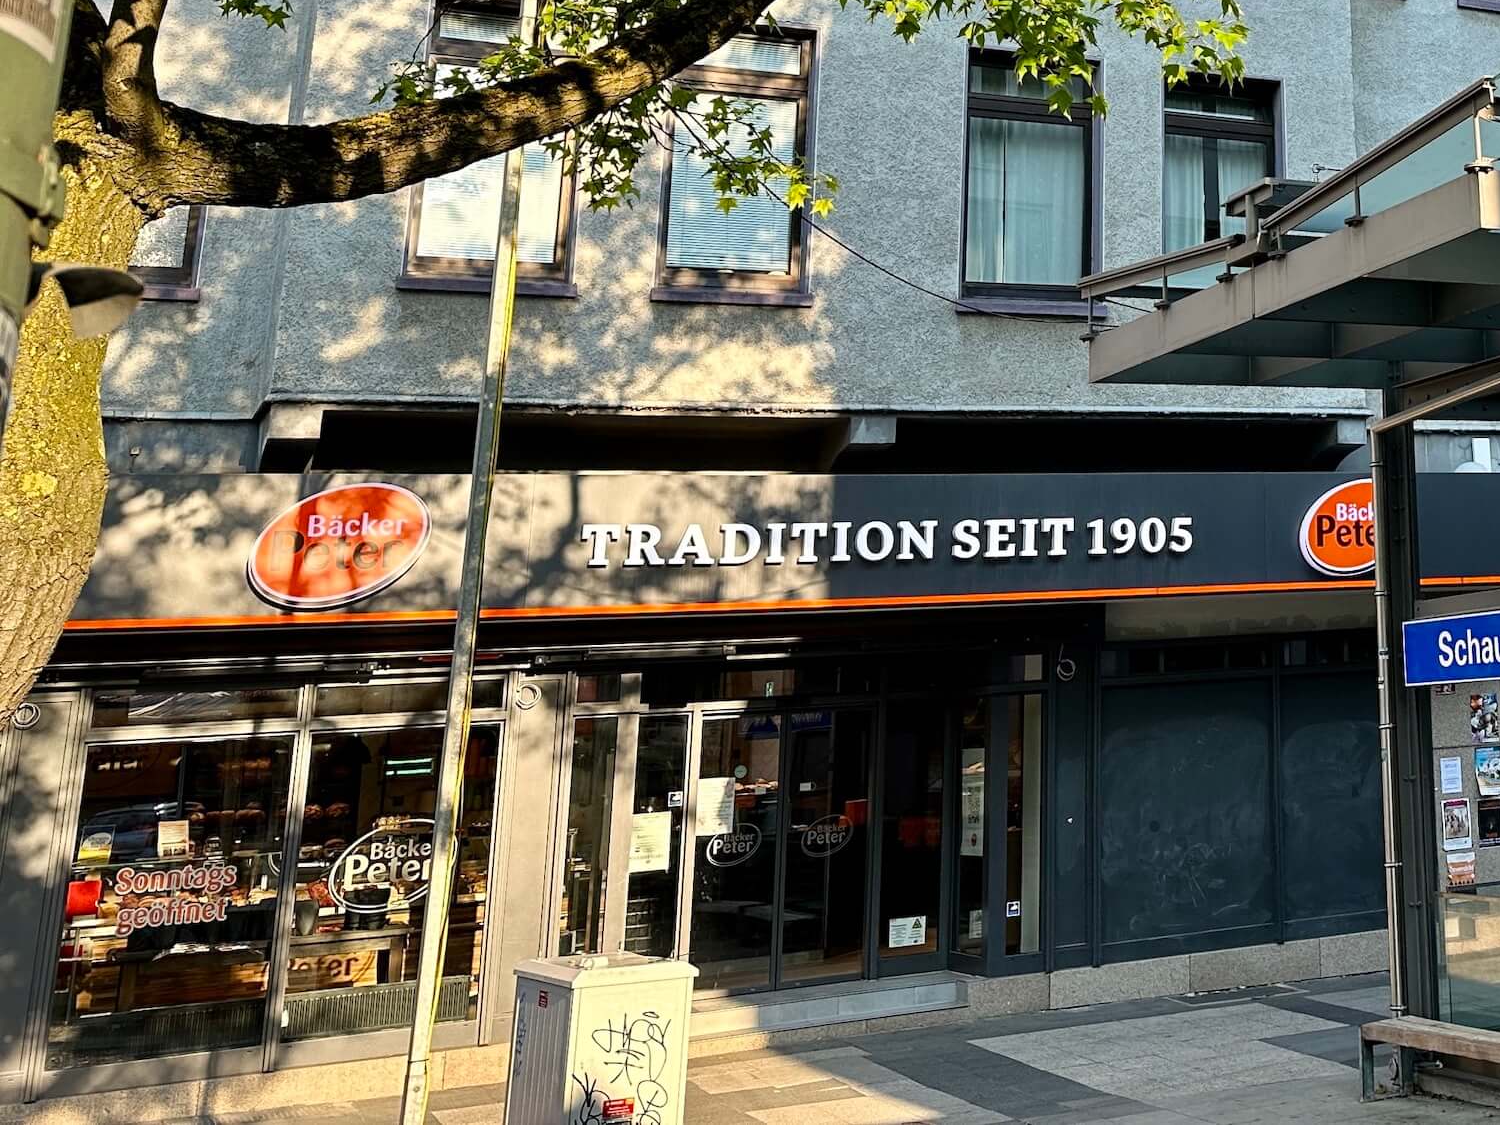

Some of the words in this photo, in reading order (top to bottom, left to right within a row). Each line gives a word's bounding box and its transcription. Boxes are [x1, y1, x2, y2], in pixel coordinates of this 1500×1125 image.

[307, 512, 408, 538] Bäcker
[1335, 501, 1374, 522] Bäck
[580, 519, 939, 567] TRADITION
[950, 516, 1075, 560] SEIT
[1086, 516, 1194, 555] 1905
[1316, 514, 1375, 548] Pete
[270, 530, 404, 572] Peter
[370, 838, 432, 860] Bäcke
[712, 838, 754, 855] Peter
[807, 830, 846, 845] Peter
[115, 863, 238, 895] Sonntags
[115, 897, 229, 937] geöffnet
